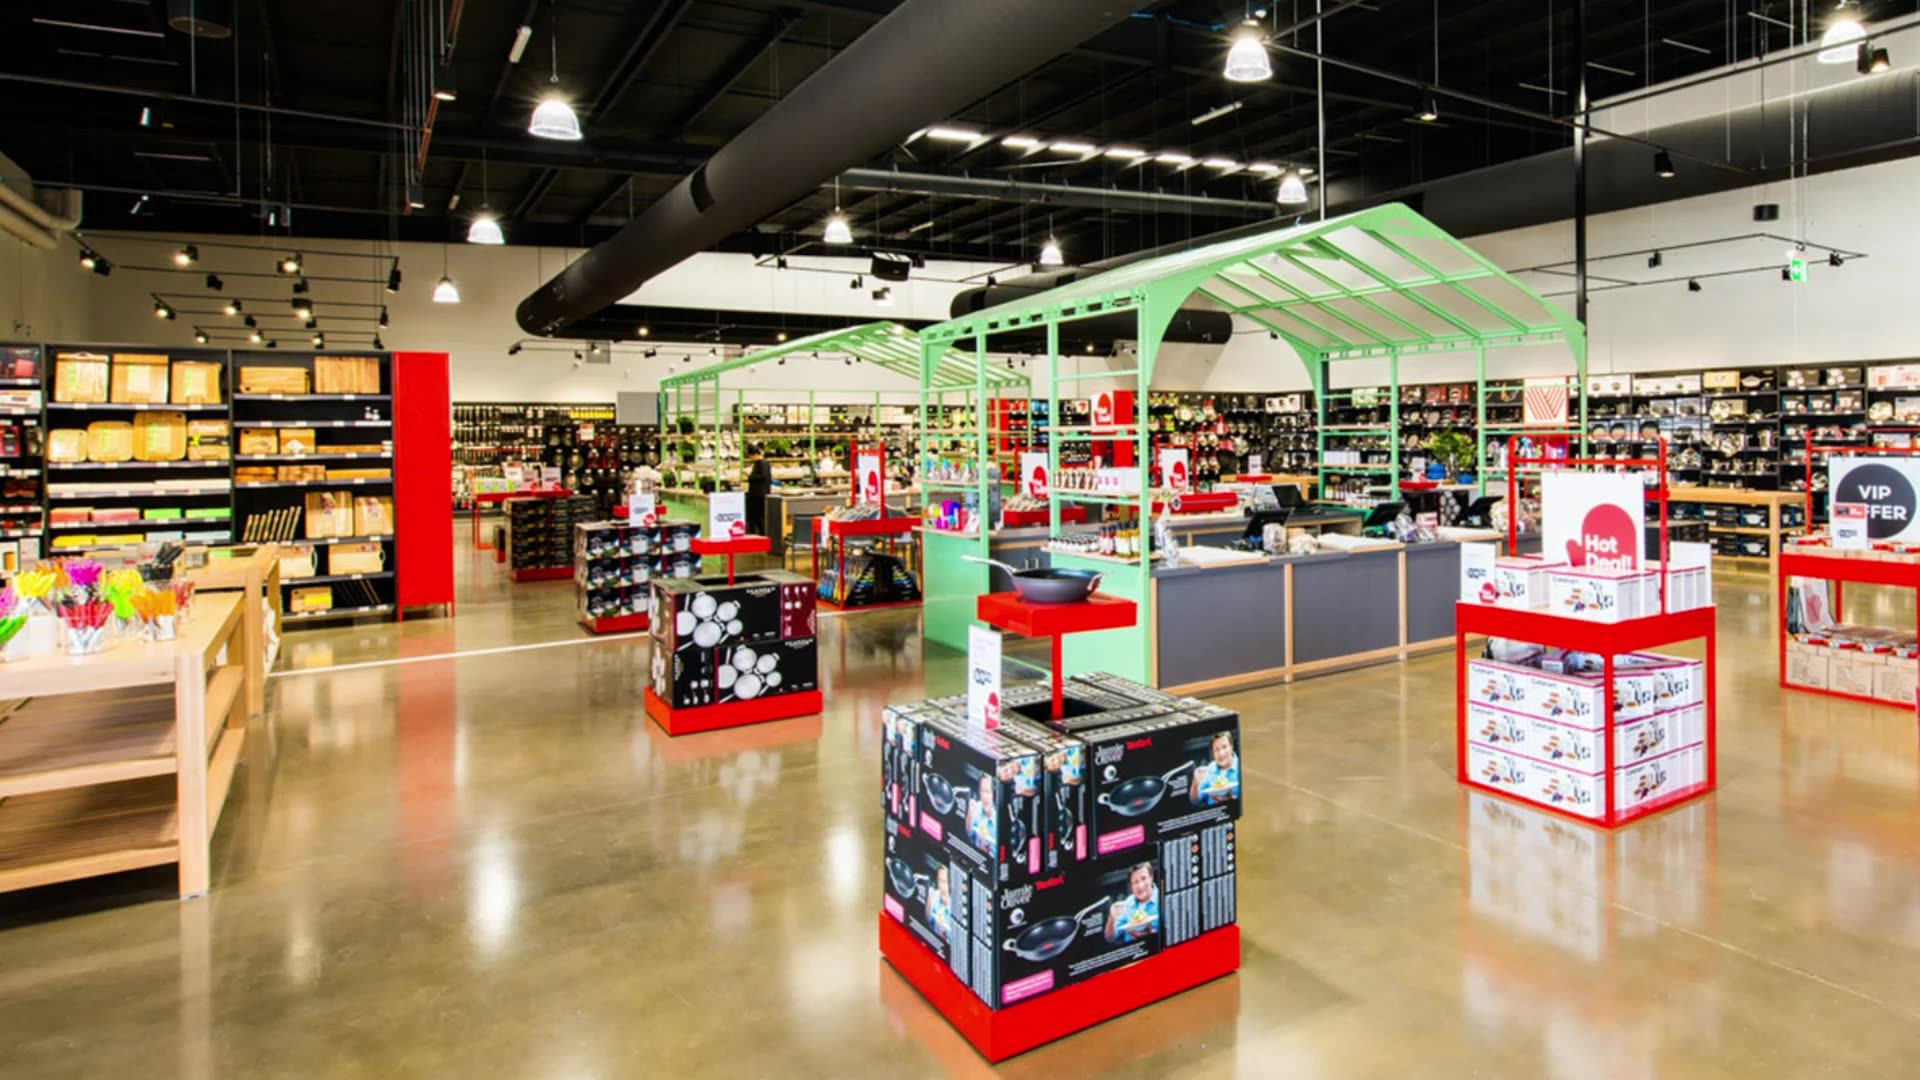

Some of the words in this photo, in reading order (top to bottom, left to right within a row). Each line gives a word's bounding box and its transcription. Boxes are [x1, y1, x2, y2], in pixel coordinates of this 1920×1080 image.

[1858, 484, 1892, 500] VIP
[1866, 504, 1907, 521] FER
[1585, 533, 1618, 554] Hot
[1585, 553, 1632, 571] Deal!
